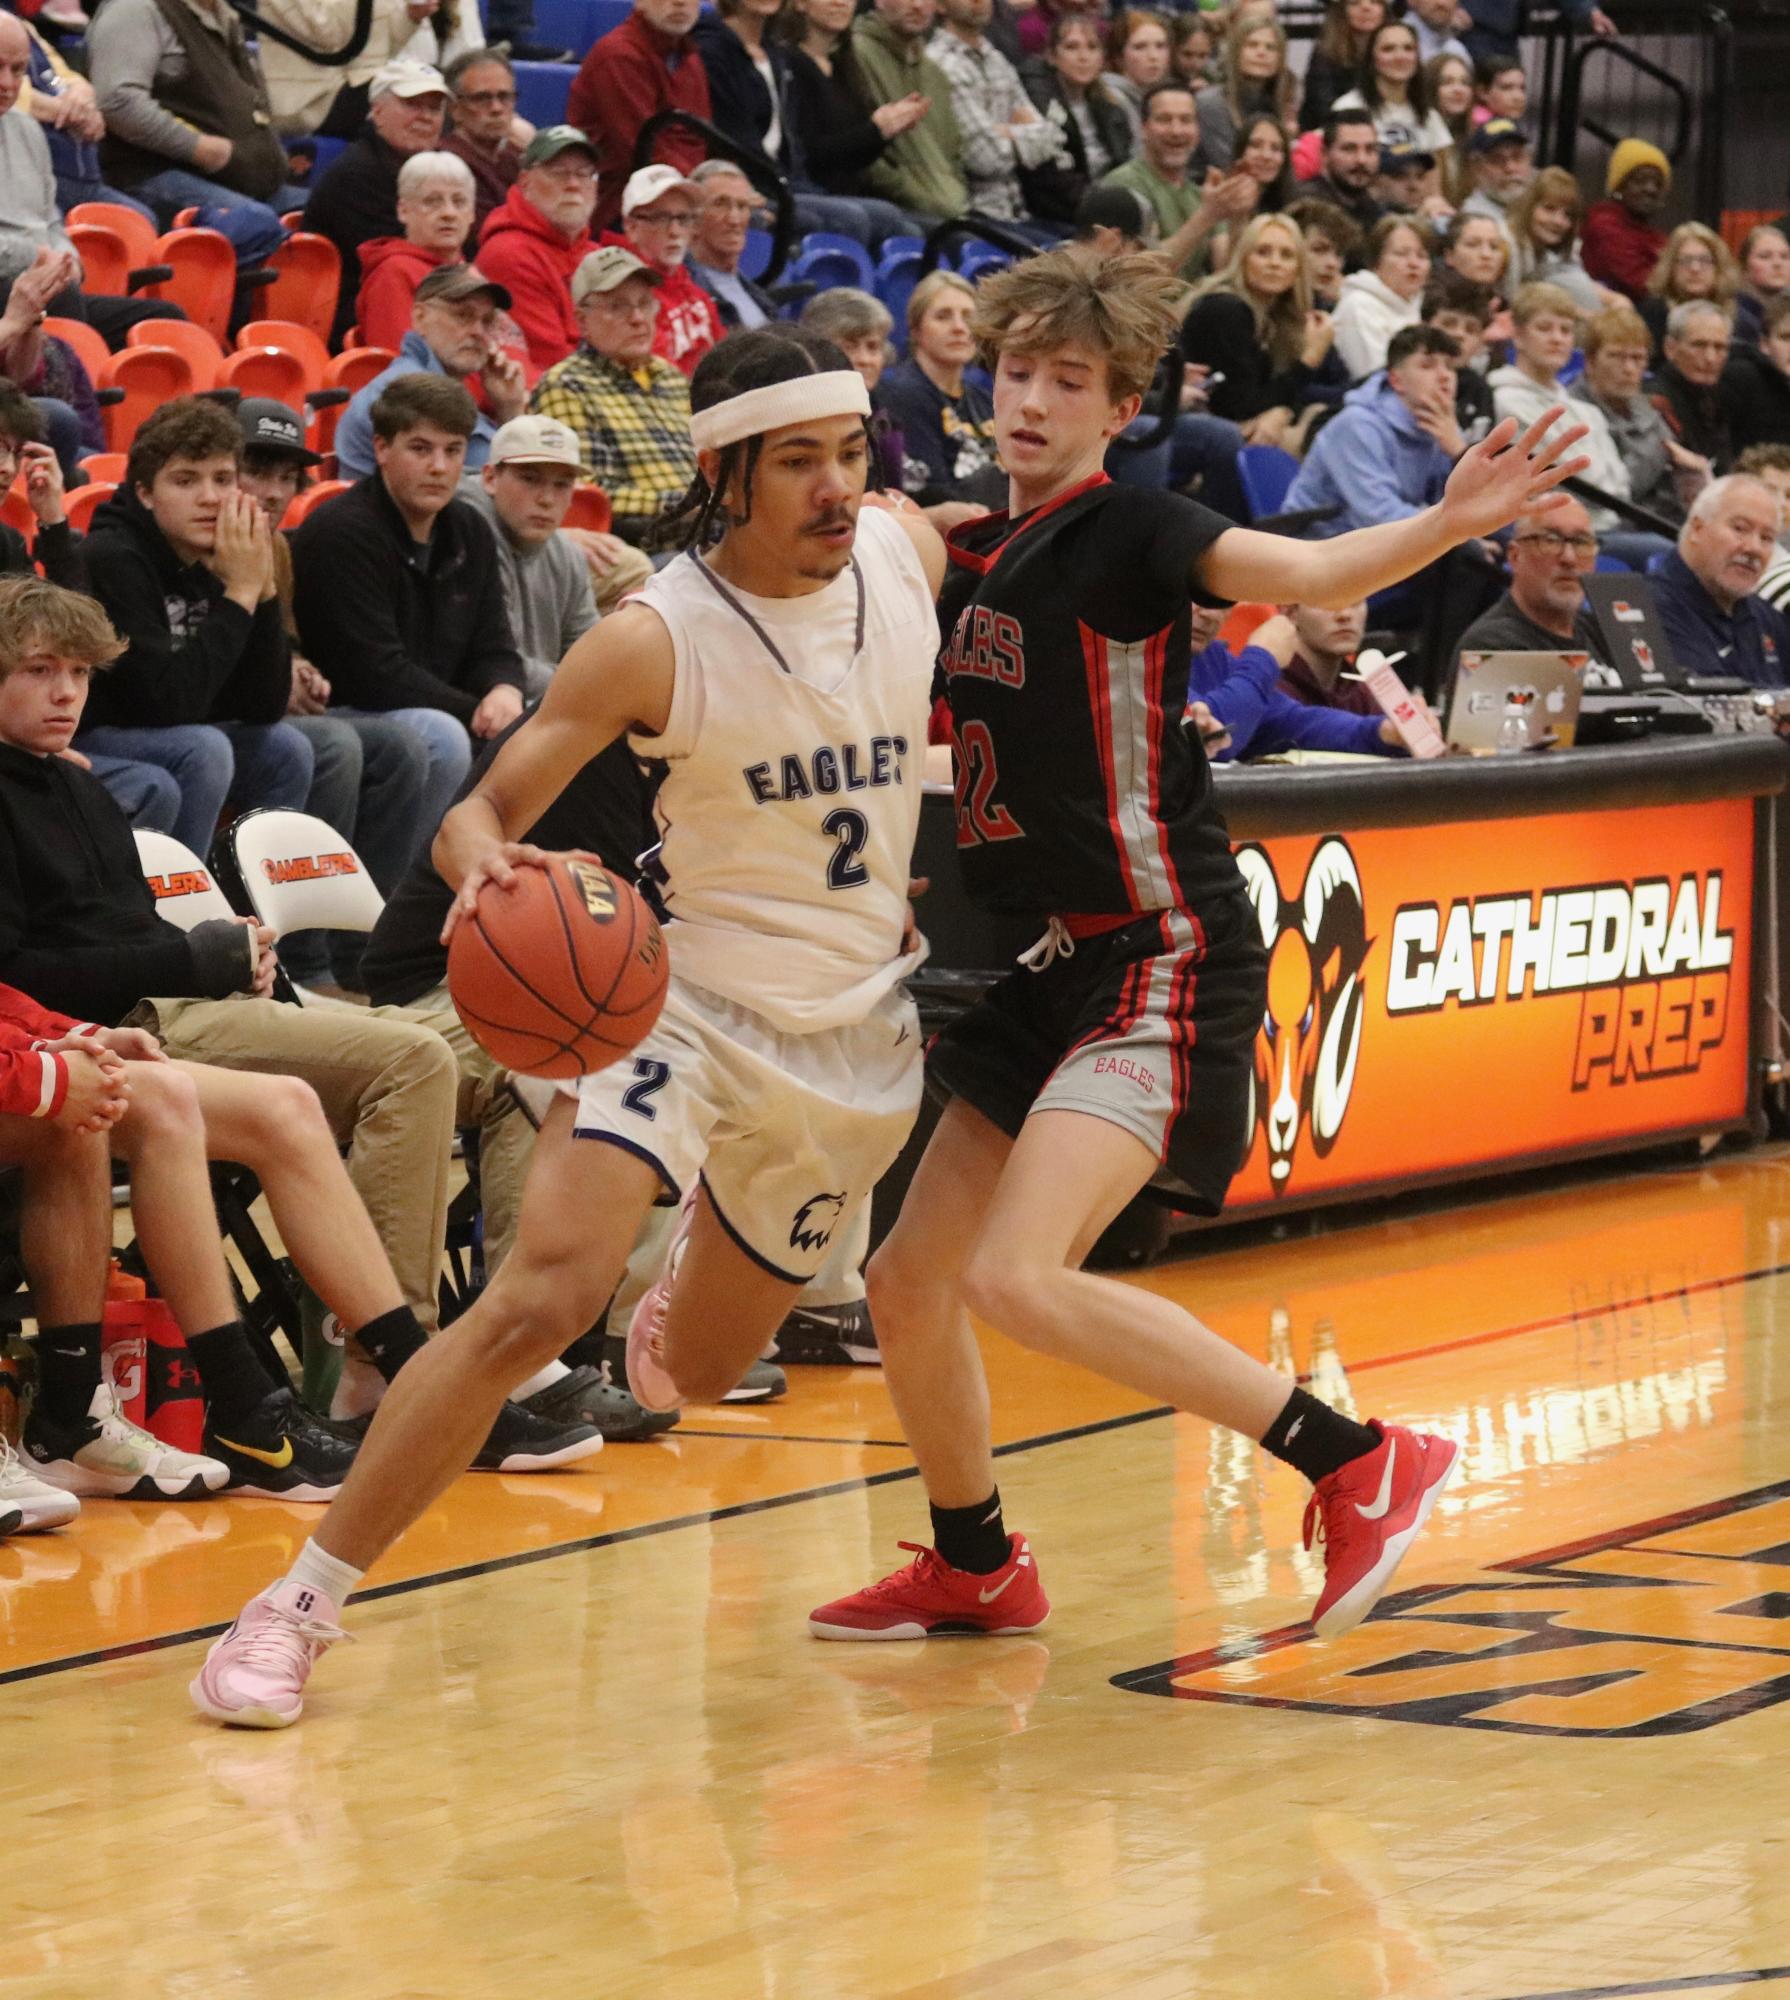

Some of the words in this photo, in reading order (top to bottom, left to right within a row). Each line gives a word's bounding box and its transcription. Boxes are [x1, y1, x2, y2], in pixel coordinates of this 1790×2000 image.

[147, 870, 211, 899] BLERS
[822, 808, 870, 890] 2
[1387, 868, 1735, 1018] CATHEDRAL
[1570, 973, 1730, 1092] PREP
[621, 1057, 672, 1121] 2
[1094, 1056, 1155, 1094] EAGLES
